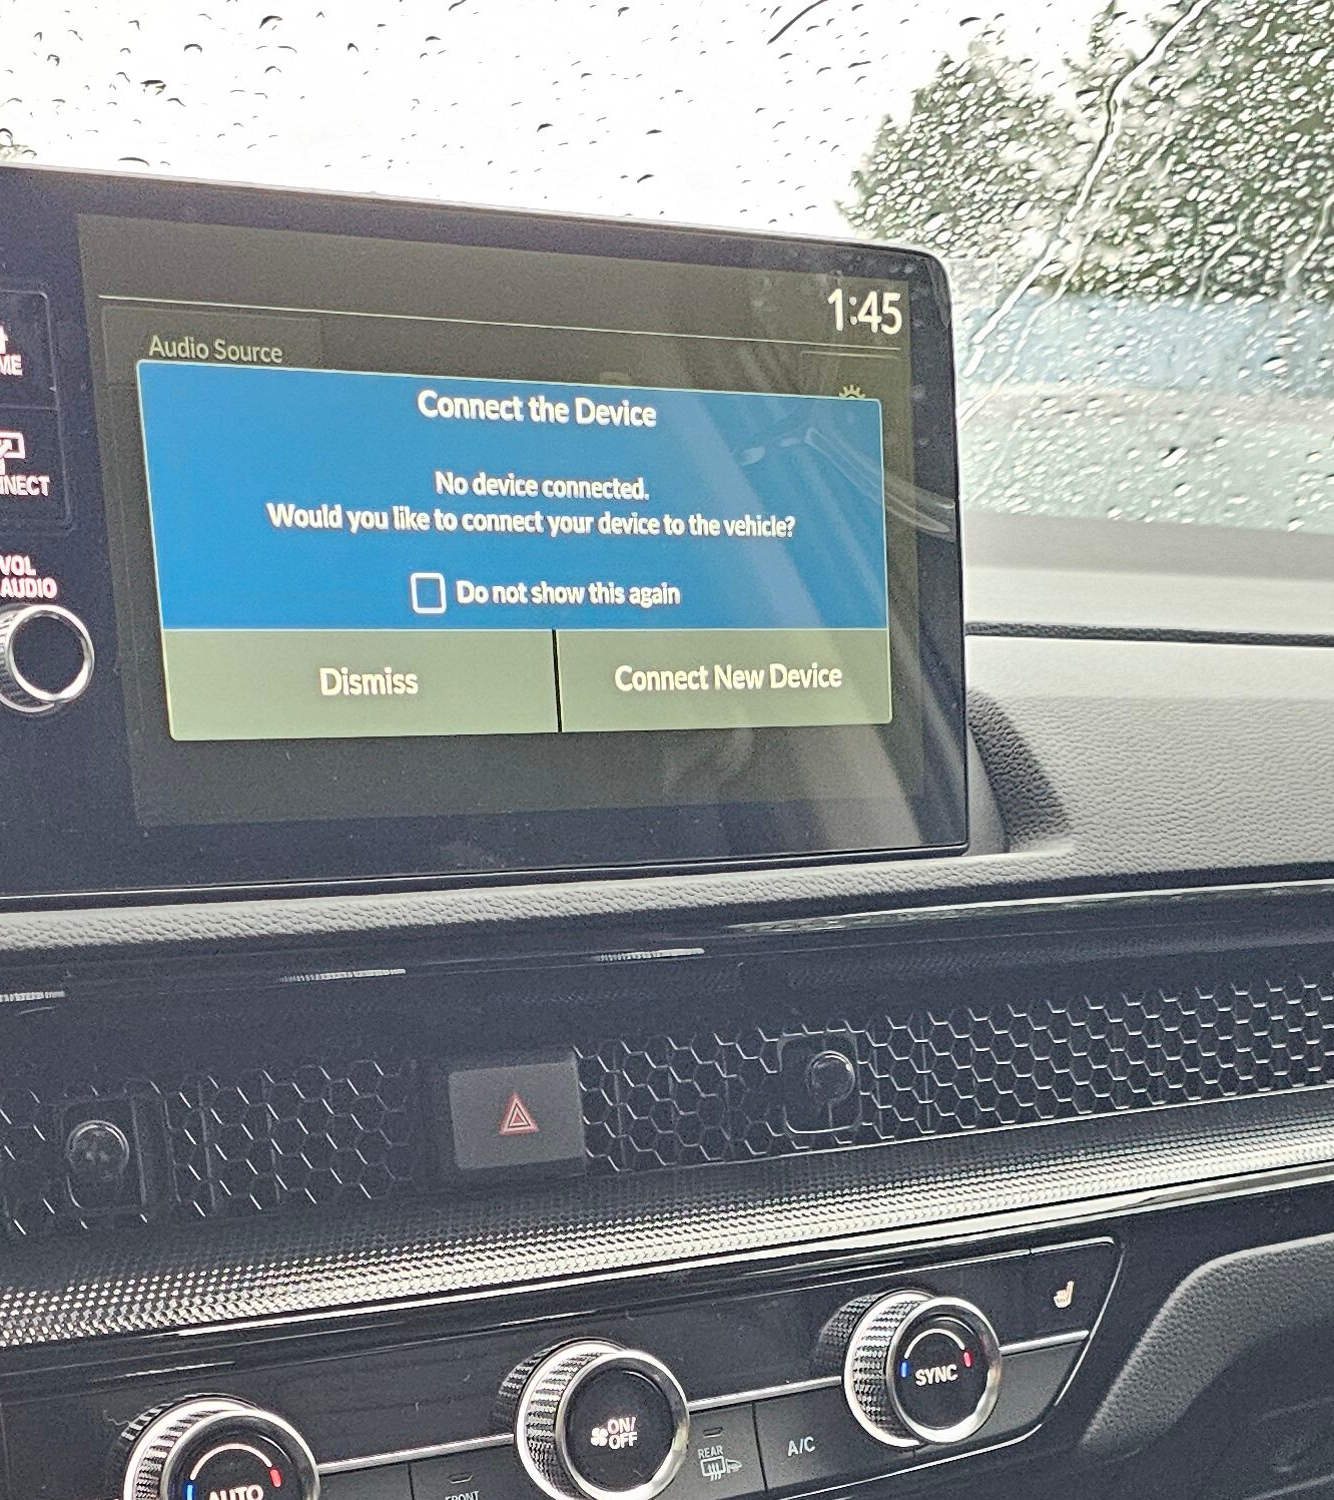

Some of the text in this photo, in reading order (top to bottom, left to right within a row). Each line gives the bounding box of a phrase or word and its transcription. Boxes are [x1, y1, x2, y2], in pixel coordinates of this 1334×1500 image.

[827, 288, 902, 335] 1:45
[149, 335, 283, 364] Audio Source
[417, 389, 657, 428] Connect the Device
[435, 470, 650, 501] No device connected.
[267, 503, 796, 538] Would you like to connect your device to the vehicle?
[0, 577, 57, 599] AUDIO
[456, 580, 680, 608] Do not show this again
[319, 664, 419, 697] Dismiss
[615, 662, 842, 692] Connect New Device
[915, 1364, 958, 1387] SYNC
[607, 1416, 637, 1433] ON/
[608, 1431, 637, 1449] OFF
[698, 1445, 723, 1459] REAR
[787, 1436, 816, 1457] A/C
